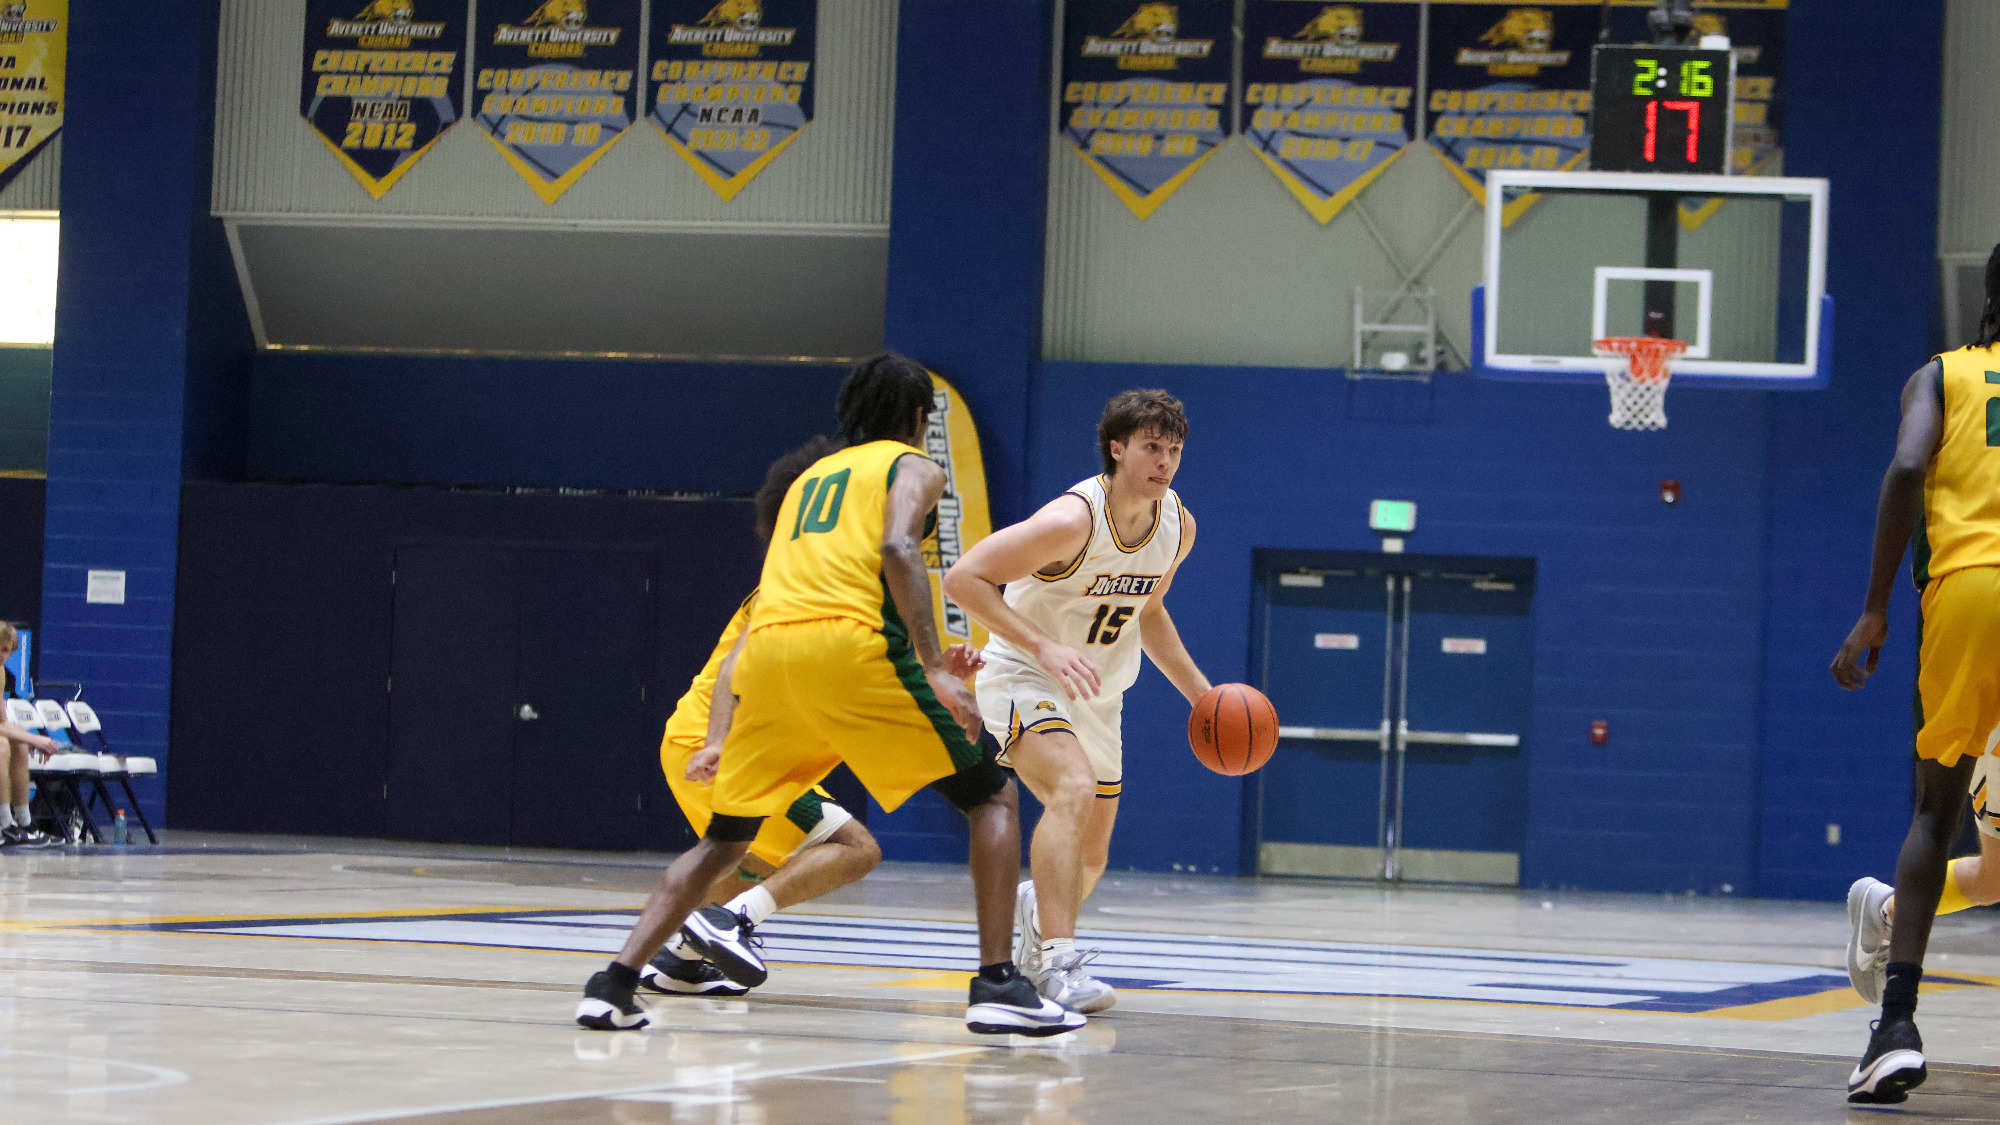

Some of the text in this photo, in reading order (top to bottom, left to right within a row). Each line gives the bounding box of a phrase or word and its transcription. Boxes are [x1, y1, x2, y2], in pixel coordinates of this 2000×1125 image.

[312, 50, 457, 73] CONFERENCE
[651, 60, 810, 81] CONFERENCE
[316, 74, 450, 98] CHAMPIONS
[477, 68, 633, 91] CONFERENCE
[1632, 59, 1714, 97] 2:16
[657, 83, 802, 103] CHAMPIONS
[1065, 82, 1228, 103] CONFERENCE
[1246, 83, 1412, 107] CONFERENCE
[352, 101, 410, 120] NCAA
[481, 94, 625, 115] CHAMPIONS
[698, 107, 761, 124] NCAA
[1069, 108, 1219, 130] CHAMPIONS
[1252, 109, 1403, 132] CHAMPIONS
[1435, 116, 1585, 137] CHAMPIONS
[0, 125, 32, 149] 17
[341, 122, 417, 149] 2012
[686, 128, 770, 150] 2021-22
[1644, 100, 1700, 163] 17
[790, 467, 852, 541] 10
[1085, 573, 1162, 596] AVERETT
[1086, 603, 1136, 646] 15
